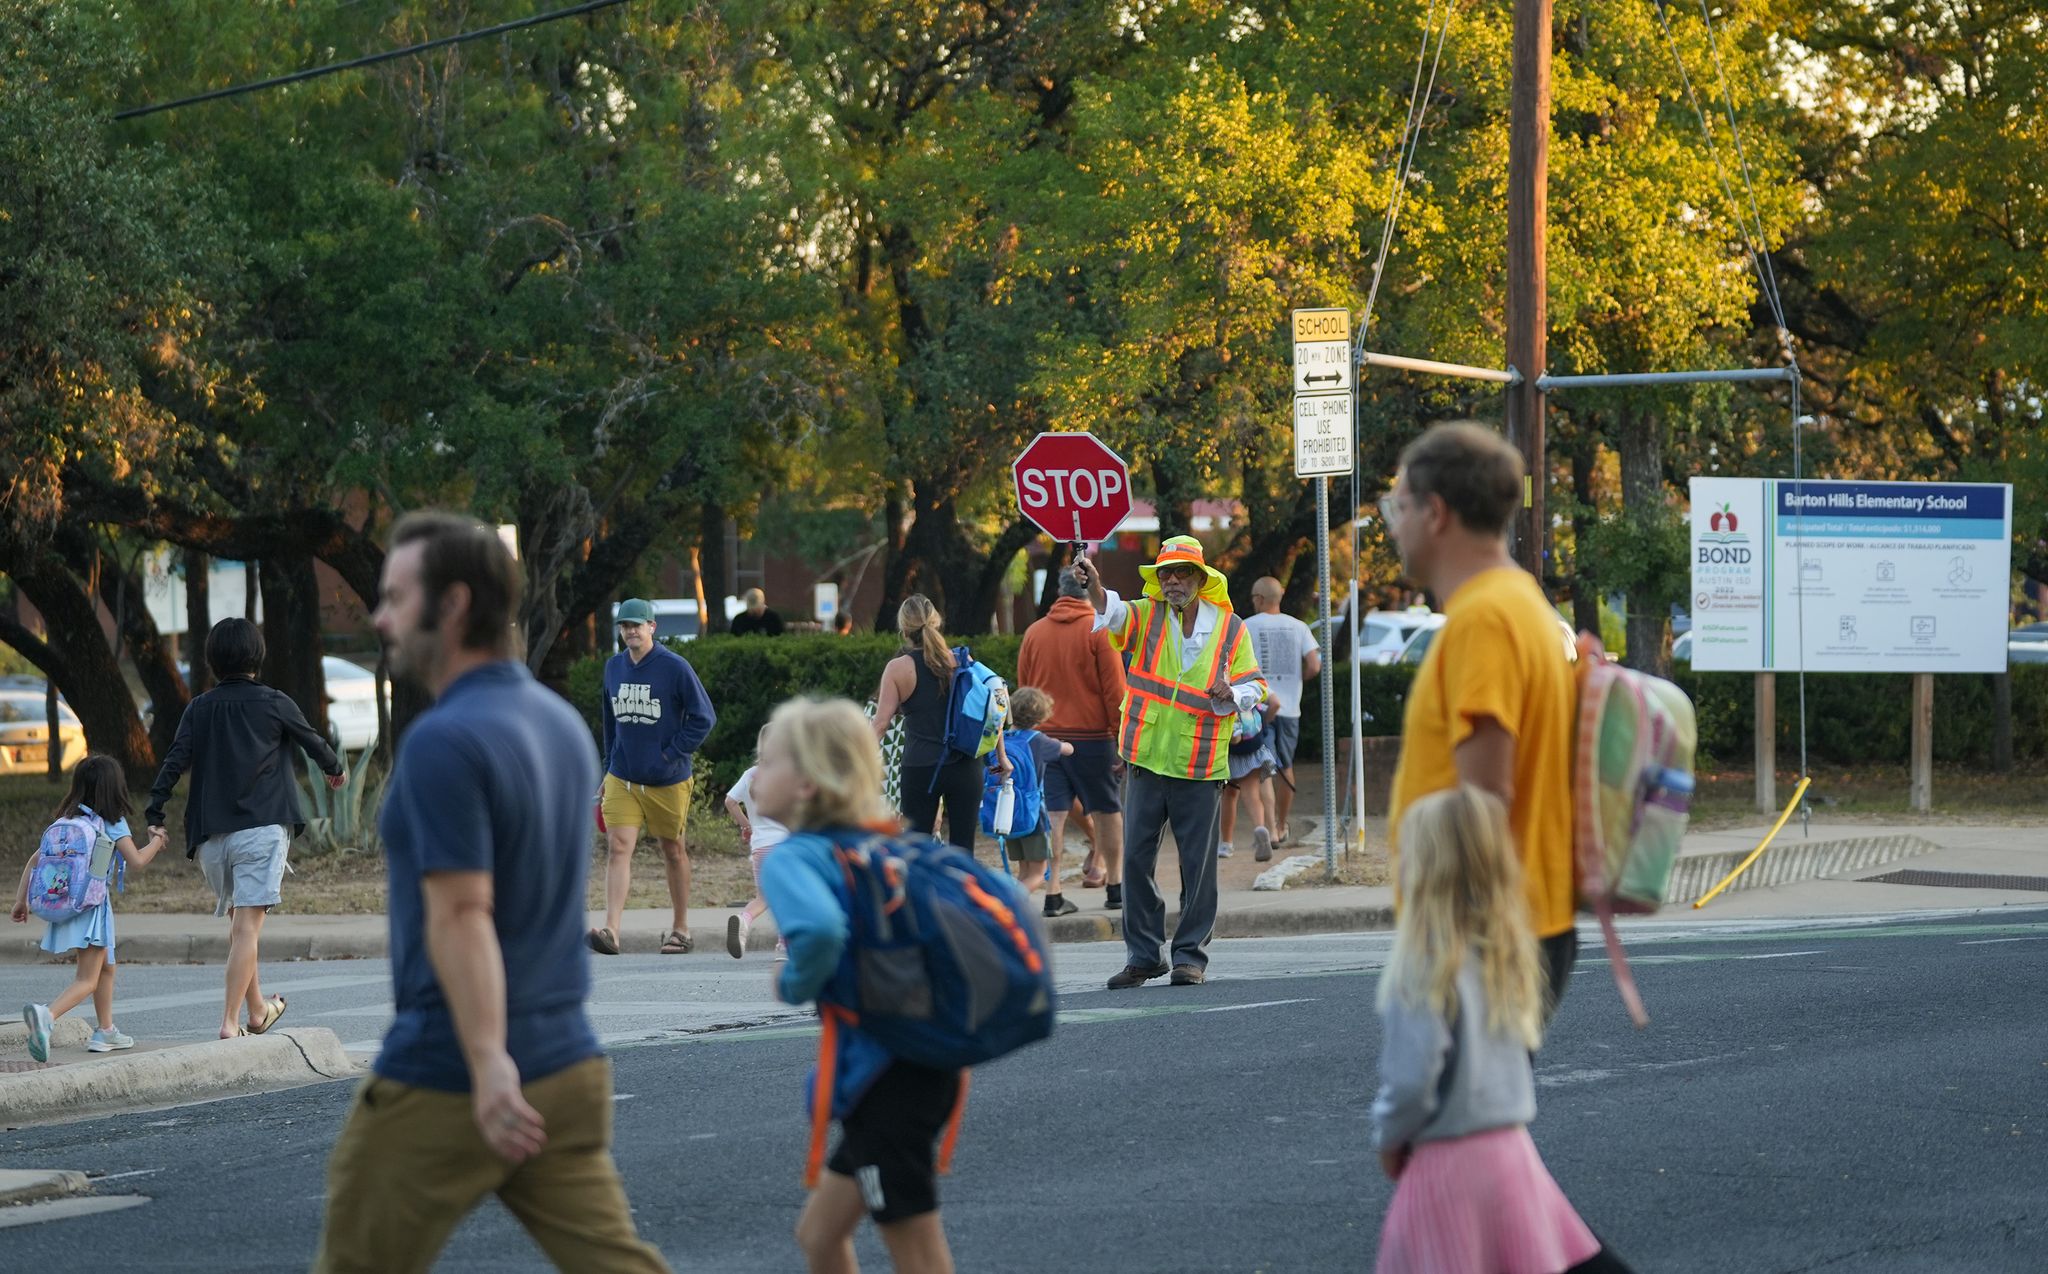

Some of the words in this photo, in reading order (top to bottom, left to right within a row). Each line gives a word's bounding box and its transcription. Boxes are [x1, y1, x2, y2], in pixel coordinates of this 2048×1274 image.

[1298, 317, 1346, 336] SCHOOL
[1298, 347, 1309, 365] 20
[1325, 346, 1347, 364] ZONE
[1299, 401, 1318, 417] CELL
[1323, 399, 1348, 416] PHONE
[1317, 419, 1331, 435] USE
[1303, 437, 1347, 454] PROHIBITED
[1300, 457, 1308, 469] UP
[1311, 457, 1318, 468] TO
[1338, 454, 1350, 466] FINE
[1022, 468, 1122, 509] STOP
[1784, 492, 1827, 507] Barton
[1828, 493, 1855, 508] Hills
[1856, 493, 1925, 512] Elementary
[1926, 494, 1968, 510] School
[1785, 522, 1826, 533] Ancipated
[1698, 547, 1752, 564] BOND
[1696, 566, 1752, 575] PROGRAM
[1698, 576, 1732, 585] AUSTIN
[618, 683, 651, 699] BHE
[611, 697, 662, 719] EAGLES
